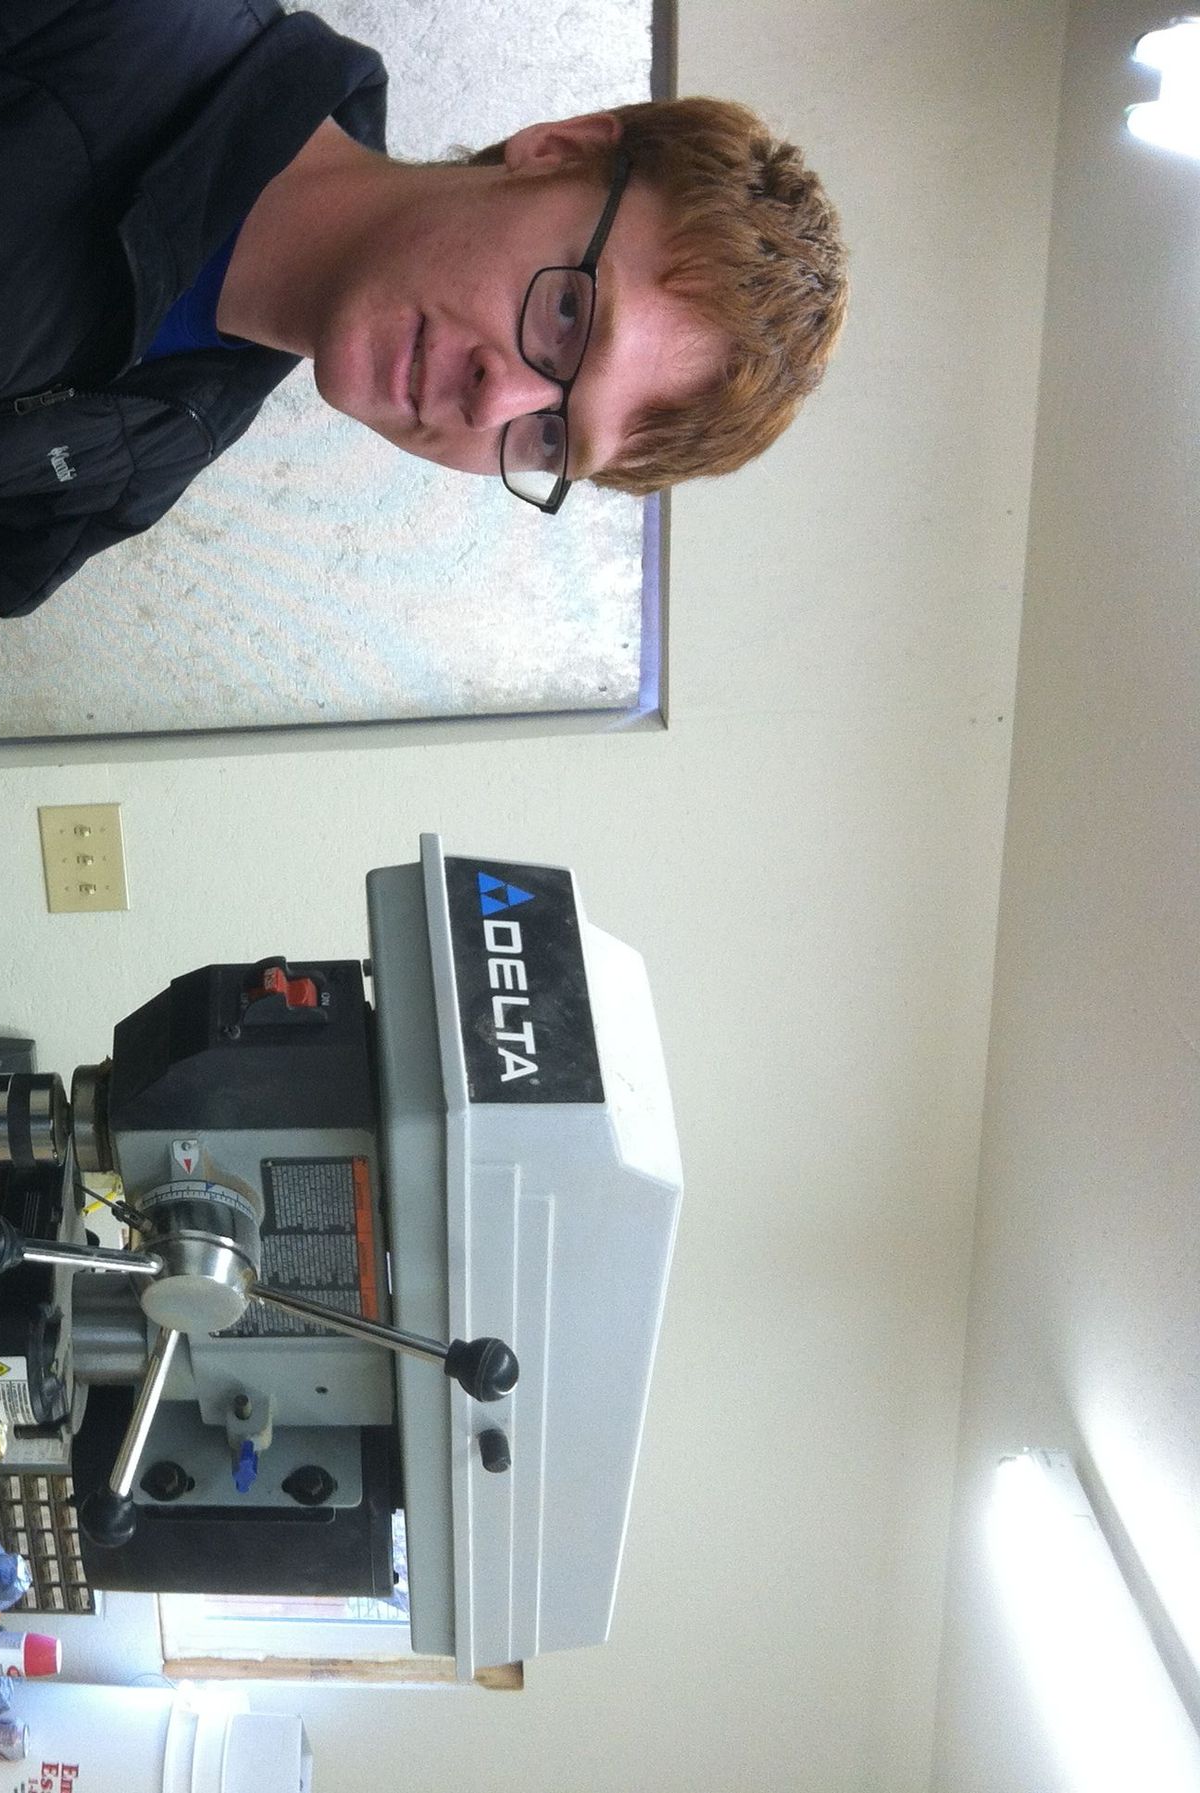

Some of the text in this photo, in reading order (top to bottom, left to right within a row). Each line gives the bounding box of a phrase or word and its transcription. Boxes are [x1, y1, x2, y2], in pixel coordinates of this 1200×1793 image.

[321, 992, 331, 1006] ON
[483, 919, 539, 1082] DELTA
[41, 1762, 59, 1793] Es
